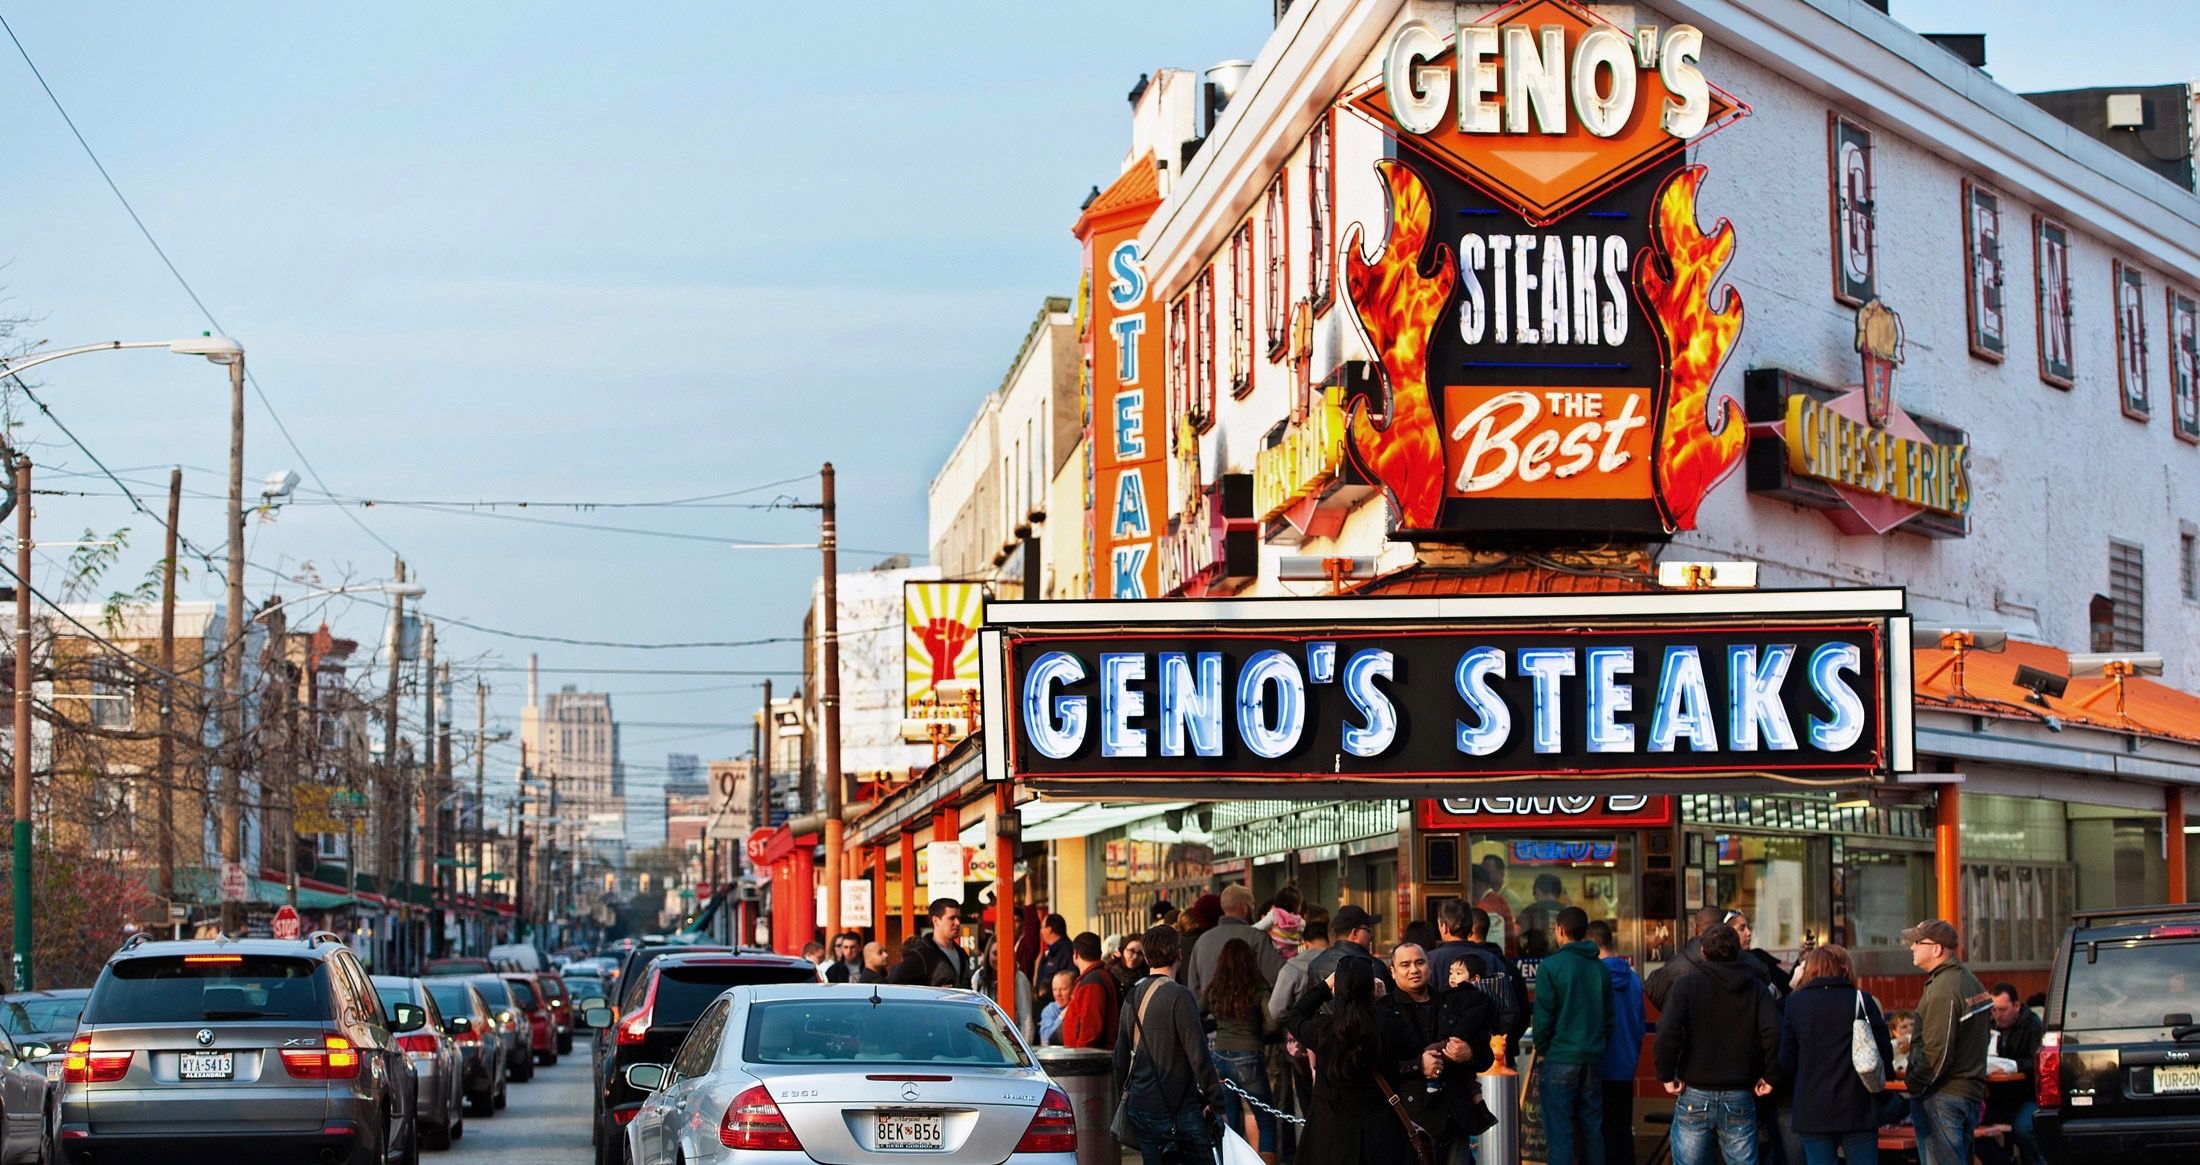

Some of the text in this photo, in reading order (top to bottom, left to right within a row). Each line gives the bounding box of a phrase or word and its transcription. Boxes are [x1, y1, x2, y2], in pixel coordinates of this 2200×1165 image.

[1383, 19, 1711, 139] GENO'S
[1459, 232, 1629, 346] STEAKS
[1545, 392, 1603, 418] THE
[1451, 390, 1647, 493] Best
[1786, 394, 1973, 515] CHEESE FRIES
[1023, 641, 1866, 759] GENO'S STEAKS
[749, 837, 768, 857] ST
[275, 918, 300, 937] STOP
[182, 1058, 231, 1072] WYA-5413
[2164, 1051, 2190, 1060] Jeep
[878, 1123, 941, 1140] 8EK B56
